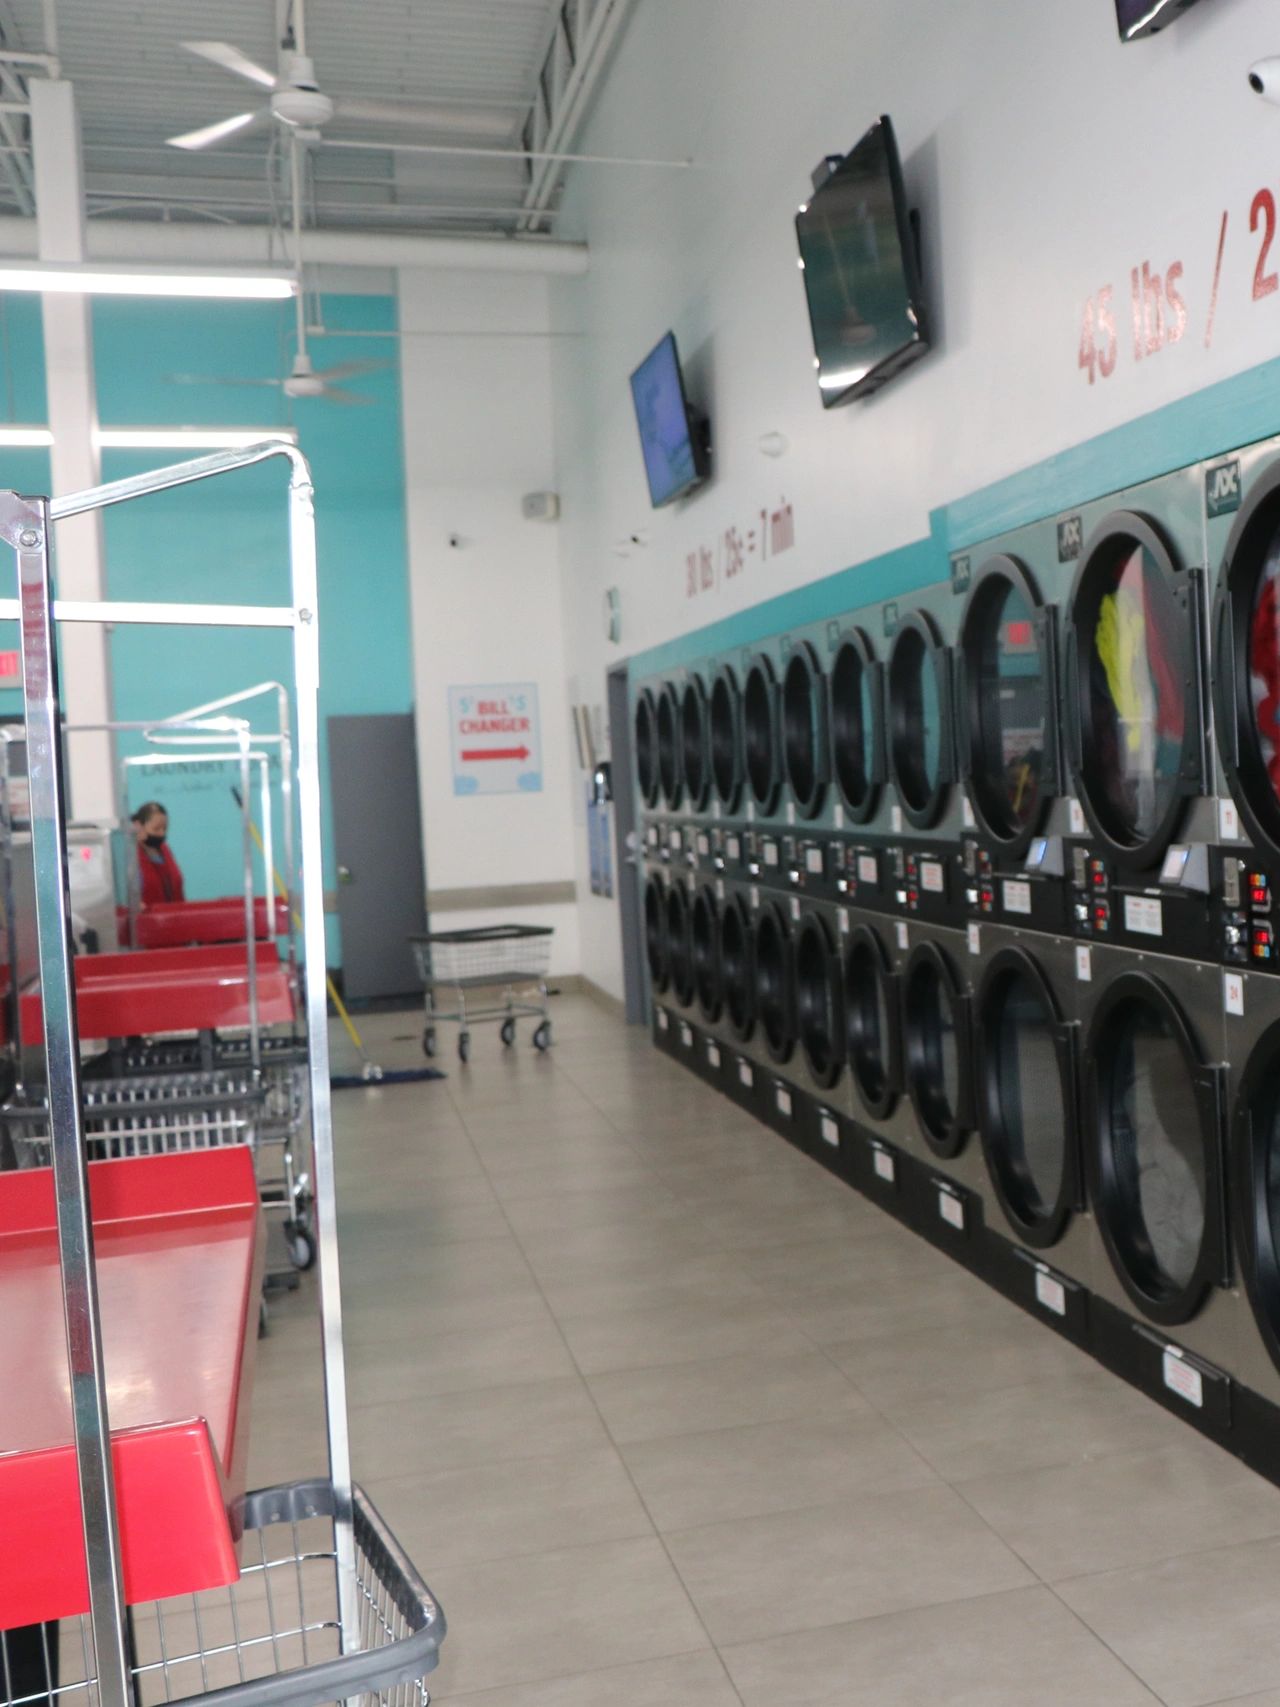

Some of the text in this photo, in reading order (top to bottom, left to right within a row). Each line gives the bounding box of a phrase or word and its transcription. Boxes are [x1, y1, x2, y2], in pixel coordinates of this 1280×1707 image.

[1078, 284, 1117, 385] 45
[1131, 260, 1187, 361] lbs
[477, 700, 509, 716] BILL
[459, 717, 530, 735] CHANGER
